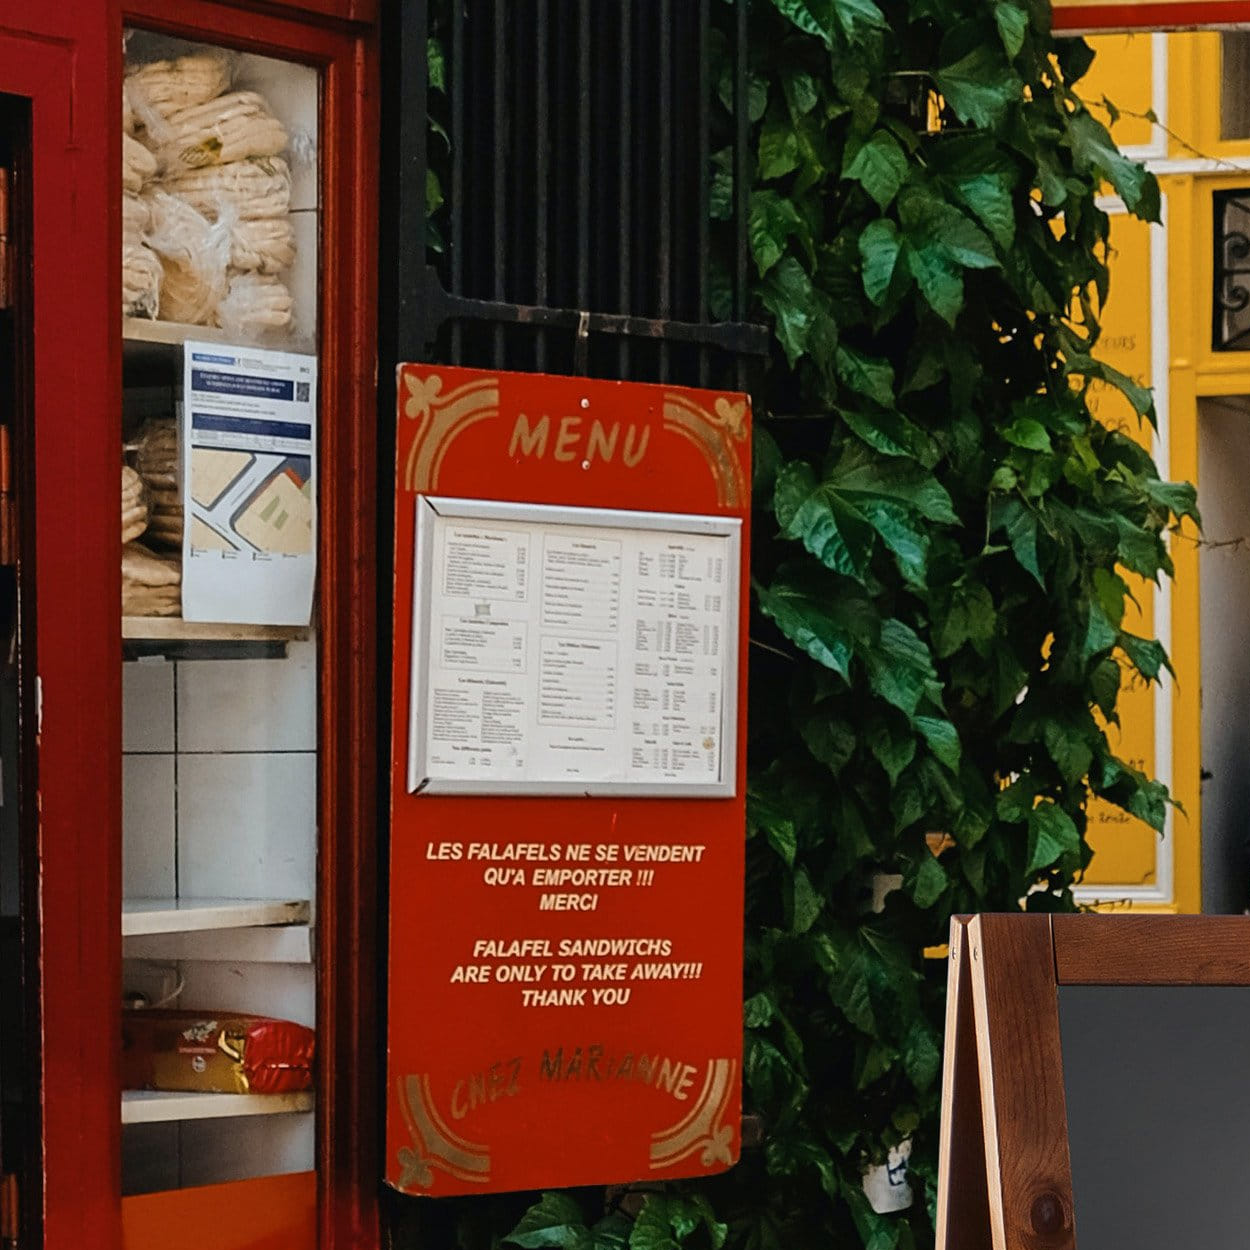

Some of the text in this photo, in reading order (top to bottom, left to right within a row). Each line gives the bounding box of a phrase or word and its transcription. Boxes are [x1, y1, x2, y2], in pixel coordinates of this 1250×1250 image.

[509, 414, 651, 468] MENU
[427, 843, 705, 861] LES FALAFELS NE SE VENDENT
[484, 868, 654, 885] QU'A EMPORTER !!!
[540, 894, 598, 910] MERCI
[474, 939, 671, 957] FALAFEL SANDWICHS
[451, 963, 702, 982] ARE ONLY TO TAKE AWAY!!!
[522, 988, 630, 1006] THANK YOU
[450, 1057, 524, 1120] CHEZ
